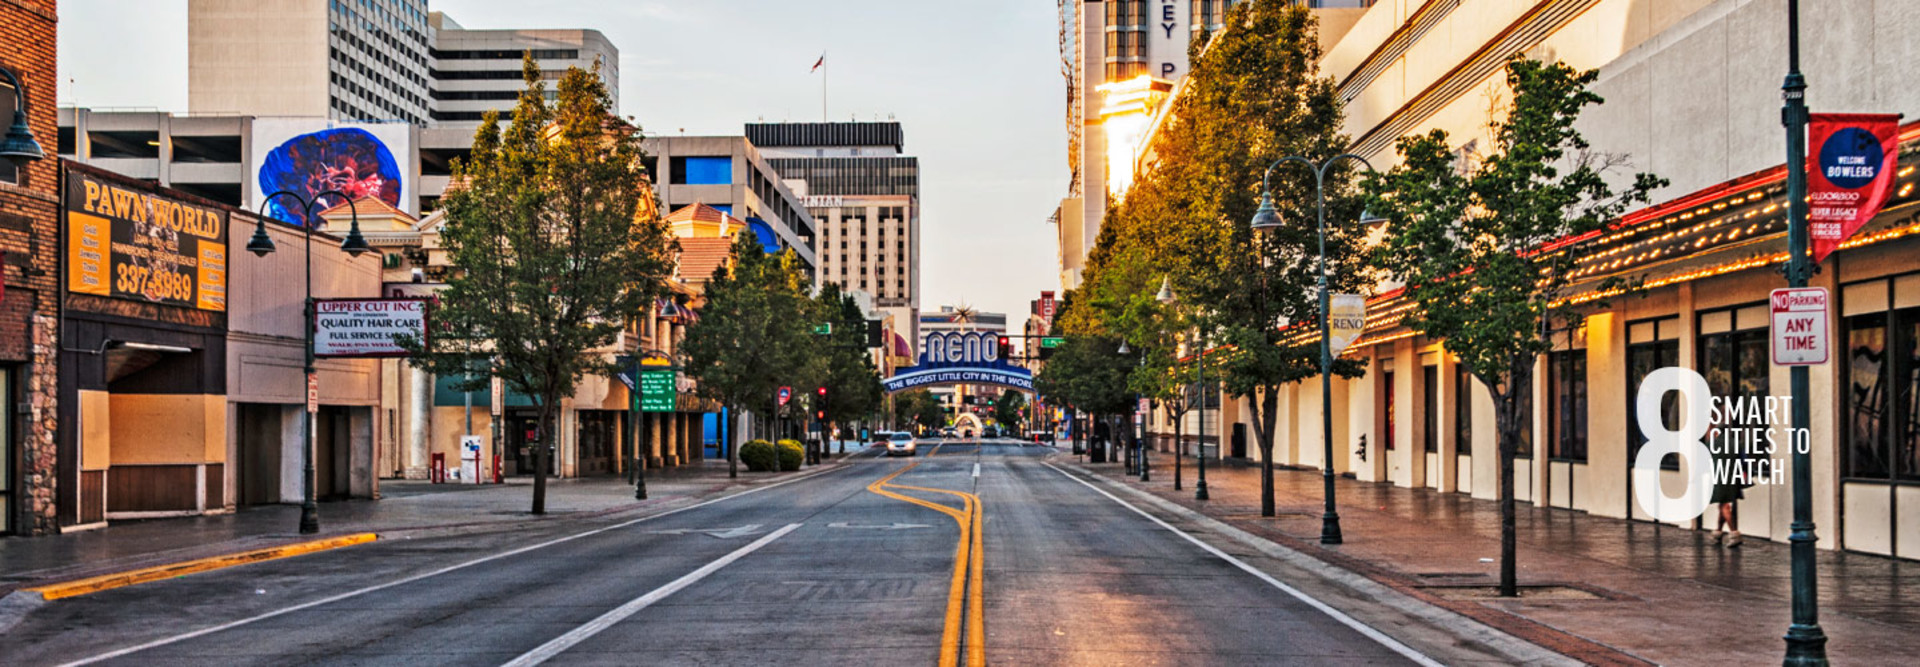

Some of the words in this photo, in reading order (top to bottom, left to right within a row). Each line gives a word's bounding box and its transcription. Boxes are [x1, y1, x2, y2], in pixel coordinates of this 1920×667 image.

[1161, 0, 1177, 39] EY
[1837, 156, 1866, 165] WELCOME
[1827, 166, 1874, 178] BOWLERS
[83, 179, 147, 224] PAWN
[152, 198, 220, 239] WORLD
[1832, 207, 1858, 217] LEGACY
[117, 262, 192, 301] 337-8989
[322, 302, 361, 312] UPPER
[364, 302, 390, 312] CUT
[393, 302, 420, 312] INC.
[1773, 294, 1789, 309] NO
[1790, 295, 1825, 306] PARKING
[321, 318, 365, 329] QUALITY
[367, 318, 393, 328] HAIR
[395, 318, 421, 328] CARE
[1333, 318, 1364, 330] RENO
[1785, 317, 1815, 333] ANY
[329, 332, 349, 340] FULL
[350, 332, 383, 340] SERVICE
[1784, 335, 1817, 351] TIME
[927, 333, 999, 363] RENO
[888, 380, 904, 391] THE
[906, 375, 937, 387] BIGGEST
[938, 372, 961, 382] LITTLE
[962, 372, 979, 381] CITY
[980, 373, 990, 382] IN
[991, 373, 1006, 384] THE
[1008, 376, 1033, 389] WORL
